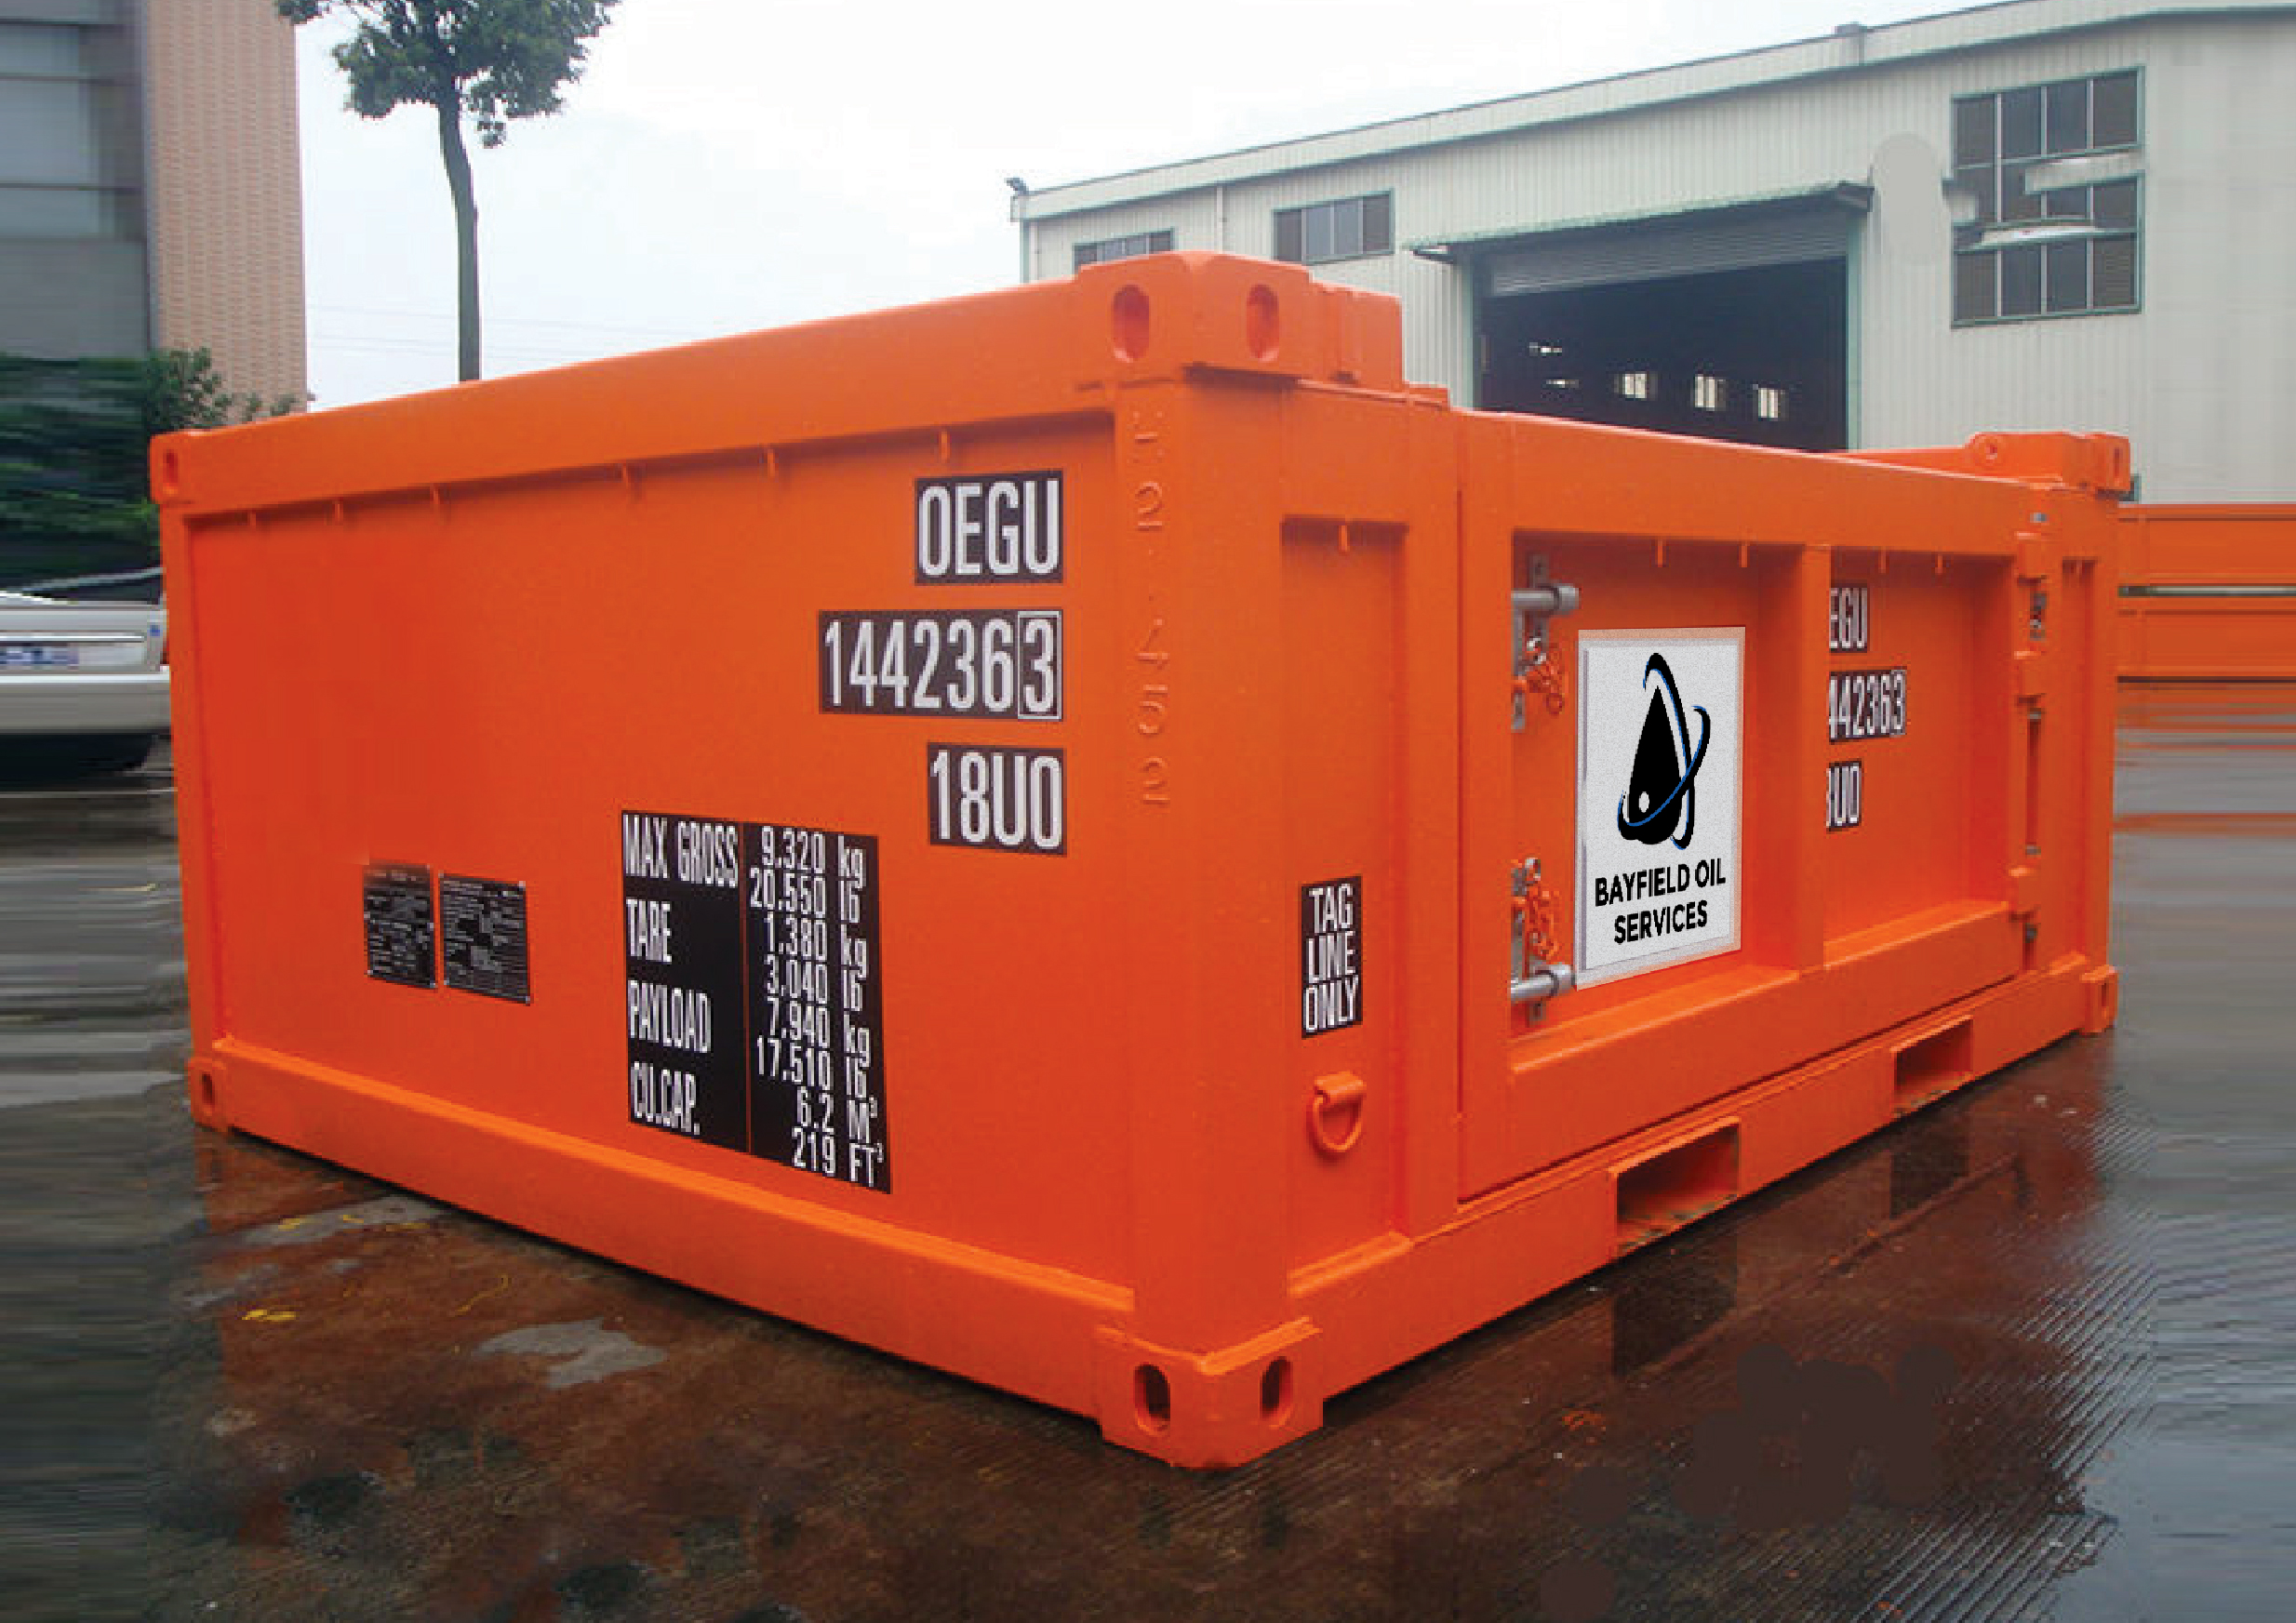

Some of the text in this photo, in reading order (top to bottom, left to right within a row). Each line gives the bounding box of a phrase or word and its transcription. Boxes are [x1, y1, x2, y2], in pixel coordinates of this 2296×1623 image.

[918, 478, 1059, 576] OEGU
[825, 618, 1058, 713] 1442363
[623, 814, 866, 889] MAX GROSS 9.320 kg
[750, 867, 861, 924] 20.550 lb
[1309, 883, 1353, 934] TAG
[1595, 858, 1727, 907] BAYFIELD OIL
[626, 898, 868, 978] TARE 1.380 kg
[1613, 899, 1708, 945] SERVICES
[765, 954, 862, 1012] 3.040 lb
[1307, 931, 1355, 984] LINE
[628, 979, 870, 1068] PAYLOAD 7.940 kg
[1304, 975, 1358, 1033] ONLY
[756, 1035, 866, 1098] 17.510 lb
[796, 1086, 834, 1133] 6.2
[791, 1126, 835, 1177] 219
